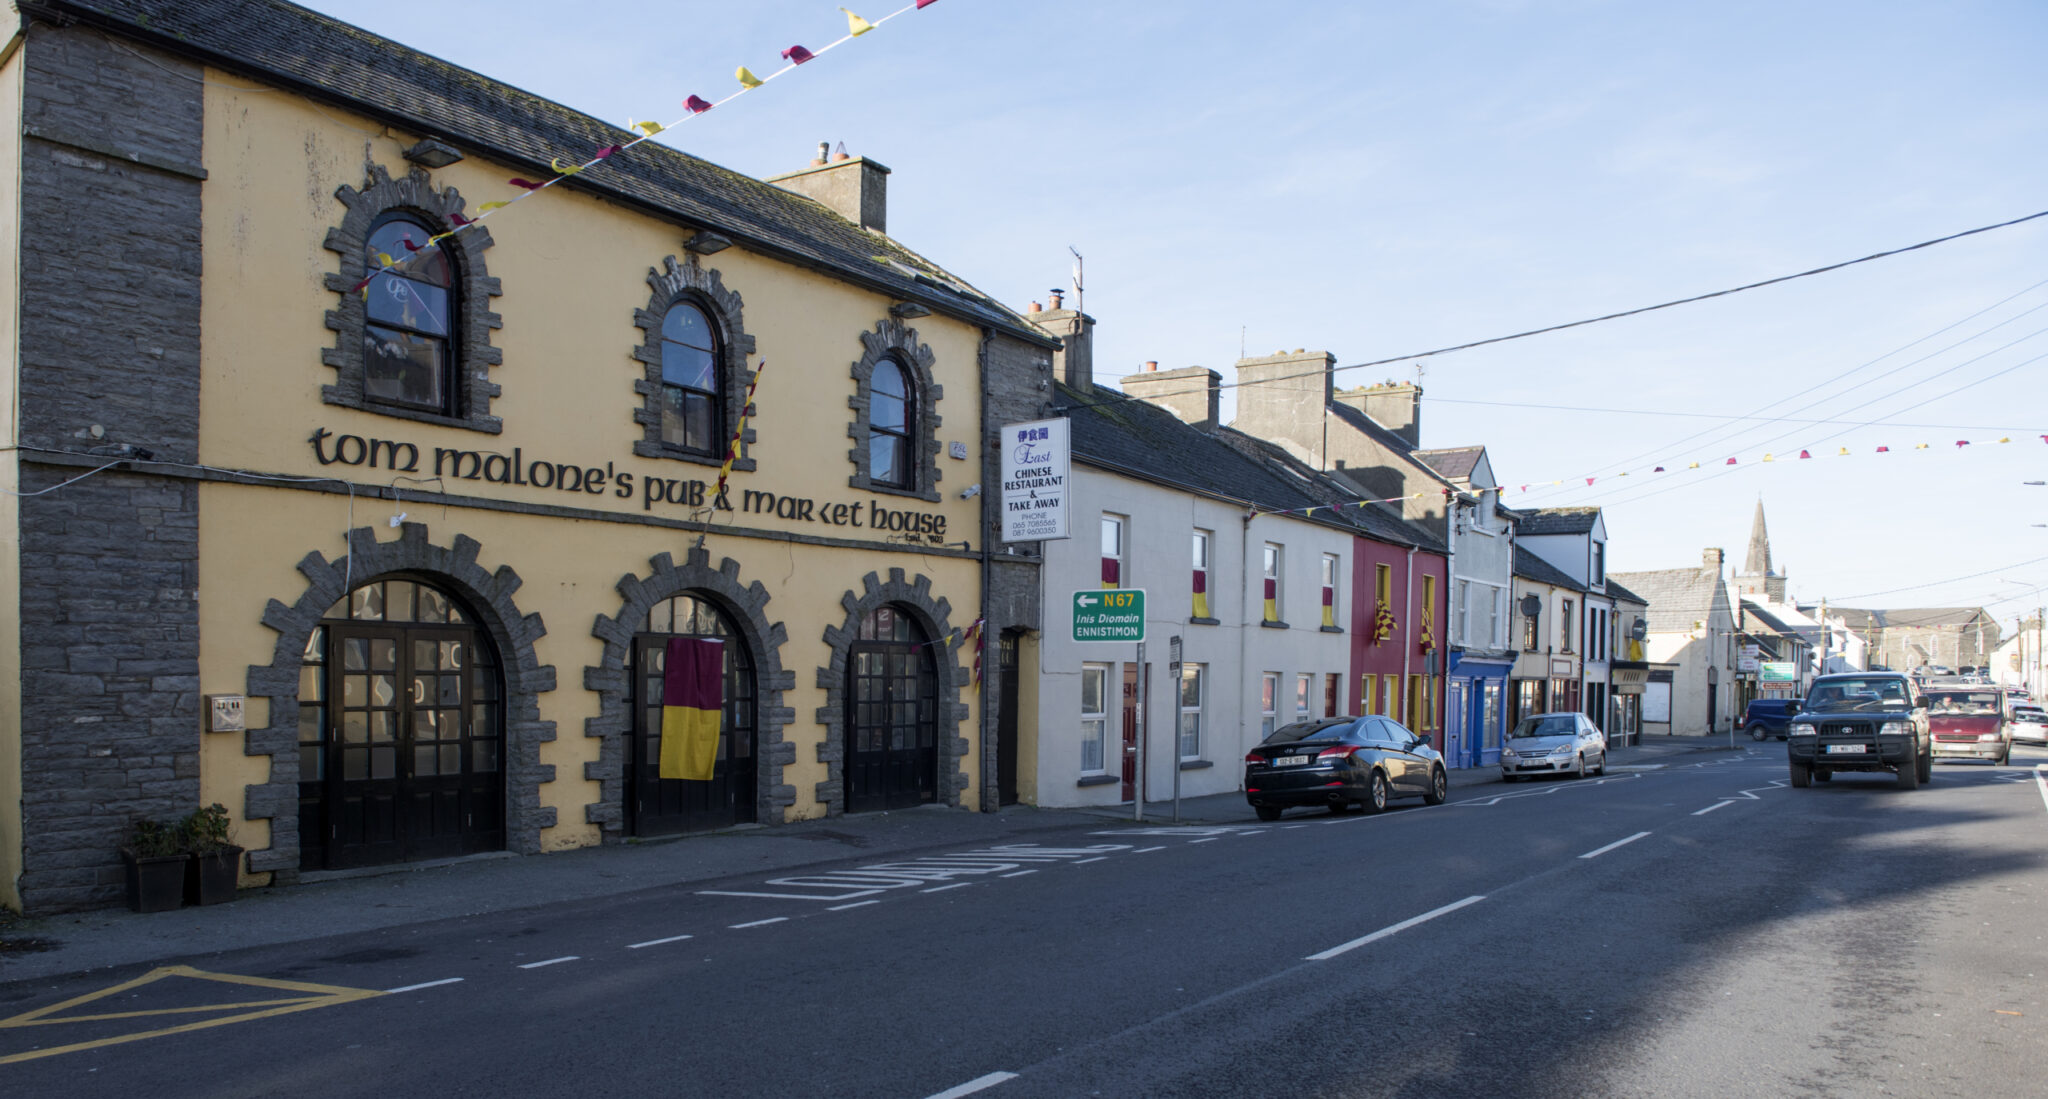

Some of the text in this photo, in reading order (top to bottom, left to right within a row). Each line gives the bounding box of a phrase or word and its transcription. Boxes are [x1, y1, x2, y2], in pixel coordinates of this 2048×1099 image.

[1013, 442, 1051, 465] East
[1015, 466, 1052, 479] CHINESE
[308, 427, 419, 473] tom
[435, 447, 634, 498] malone's
[870, 500, 947, 536] house
[1005, 476, 1063, 491] RESTAURANT
[1030, 489, 1037, 499] &
[1008, 498, 1060, 511] TAKE AWAY
[1021, 511, 1047, 520] PHONE
[1104, 593, 1134, 607] N67
[1076, 614, 1095, 624] Inis
[1076, 626, 1138, 637] ENNISTIMON
[693, 843, 1134, 901] LOADING
